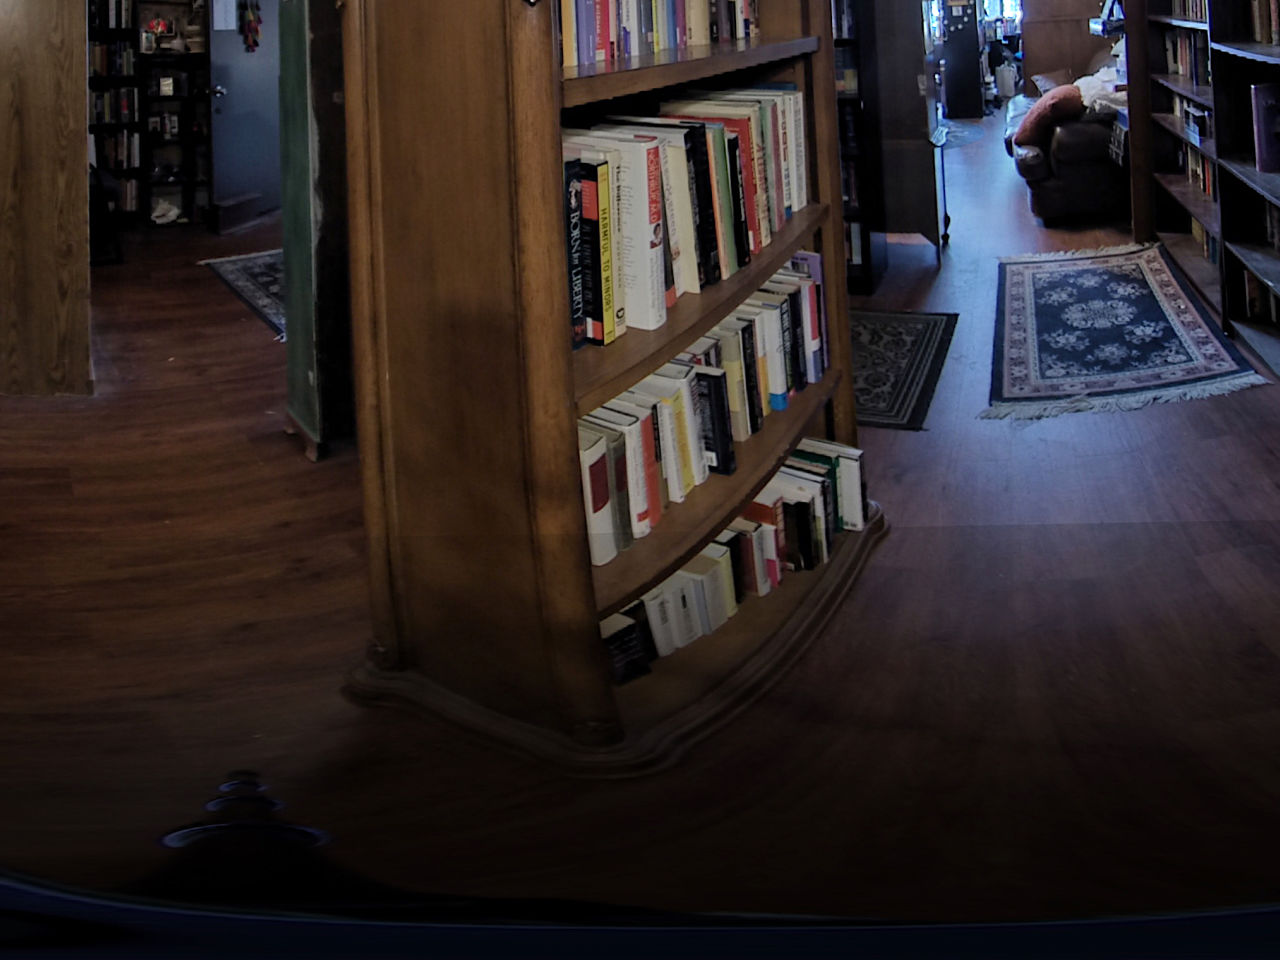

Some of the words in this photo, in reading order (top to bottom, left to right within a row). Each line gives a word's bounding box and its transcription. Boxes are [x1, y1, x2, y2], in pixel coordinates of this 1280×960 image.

[570, 210, 581, 253] BORN
[600, 207, 609, 257] HARMFUL
[602, 260, 610, 273] TO
[571, 266, 584, 320] LIBERTY
[604, 276, 613, 313] MINORS
